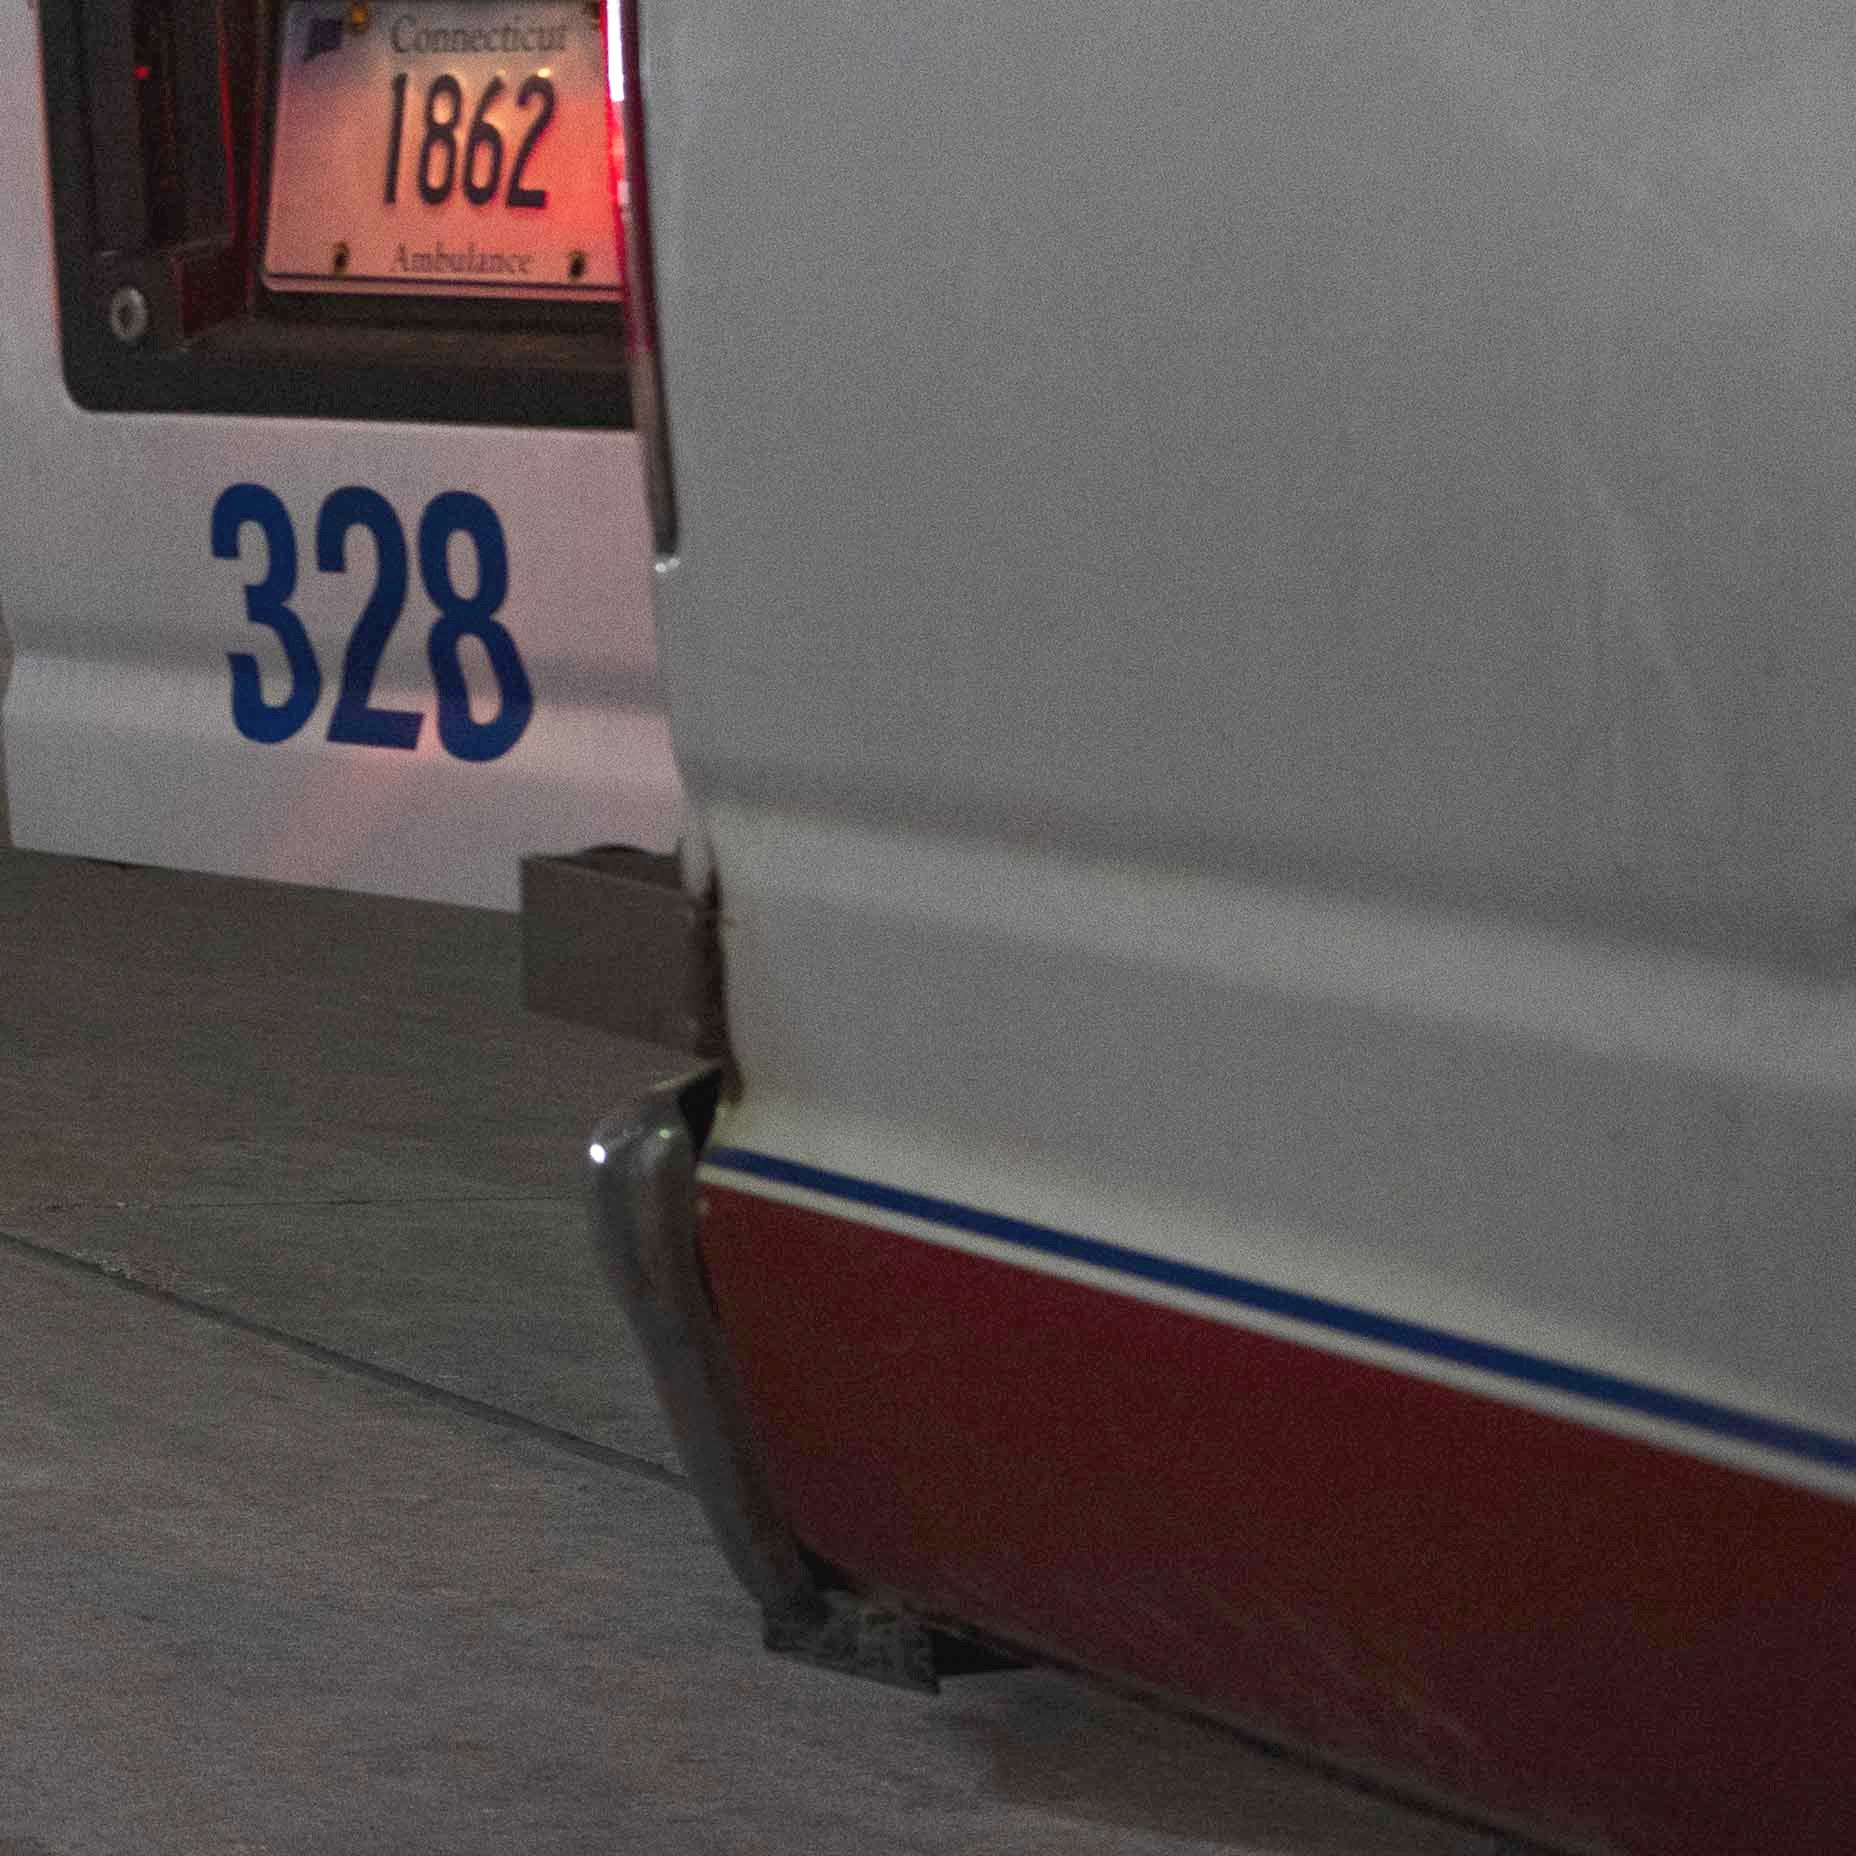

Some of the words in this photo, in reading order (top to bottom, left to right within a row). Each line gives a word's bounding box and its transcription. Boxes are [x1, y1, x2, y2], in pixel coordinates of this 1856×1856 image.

[389, 13, 570, 55] Connecticut
[383, 72, 558, 210] 1862
[389, 242, 536, 276] Ambulance
[210, 482, 535, 763] 328
